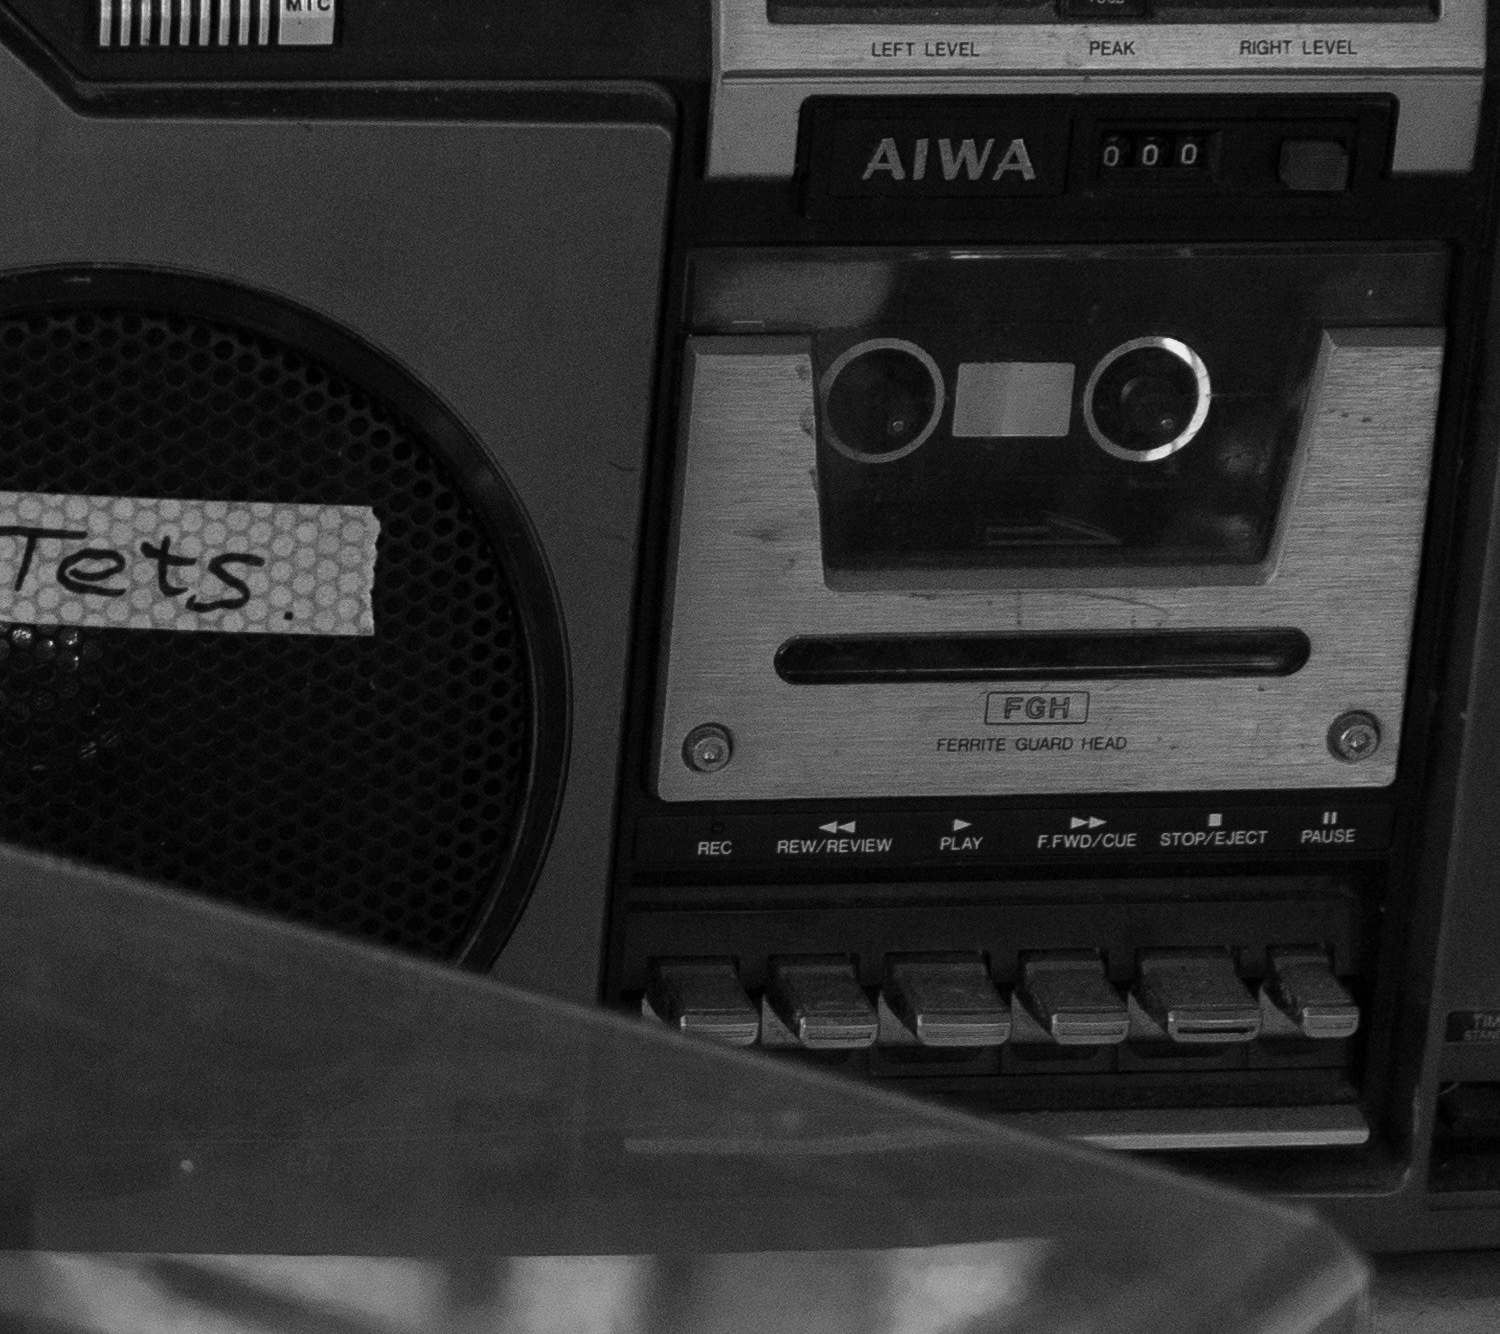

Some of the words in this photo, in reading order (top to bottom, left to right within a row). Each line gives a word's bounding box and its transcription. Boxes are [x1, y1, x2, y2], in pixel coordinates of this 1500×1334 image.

[871, 42, 916, 57] LEFT
[923, 42, 980, 57] LEVEL
[1088, 40, 1136, 56] PEAK
[1239, 40, 1292, 56] RIGHT
[1302, 40, 1358, 56] LEVEL
[860, 136, 1038, 182] AIWA
[1003, 696, 1070, 719] FGH
[936, 737, 1007, 752] FERRITE
[1015, 736, 1074, 752] GUARD
[1081, 736, 1128, 751] HEAD
[938, 835, 984, 852] PLAY
[1036, 832, 1138, 849] F.FWD/CUE
[1159, 829, 1269, 847] STOP/EJECT
[1299, 827, 1357, 844] PAUSE
[697, 840, 734, 857] REC
[776, 837, 894, 855] REW/REVIEW
